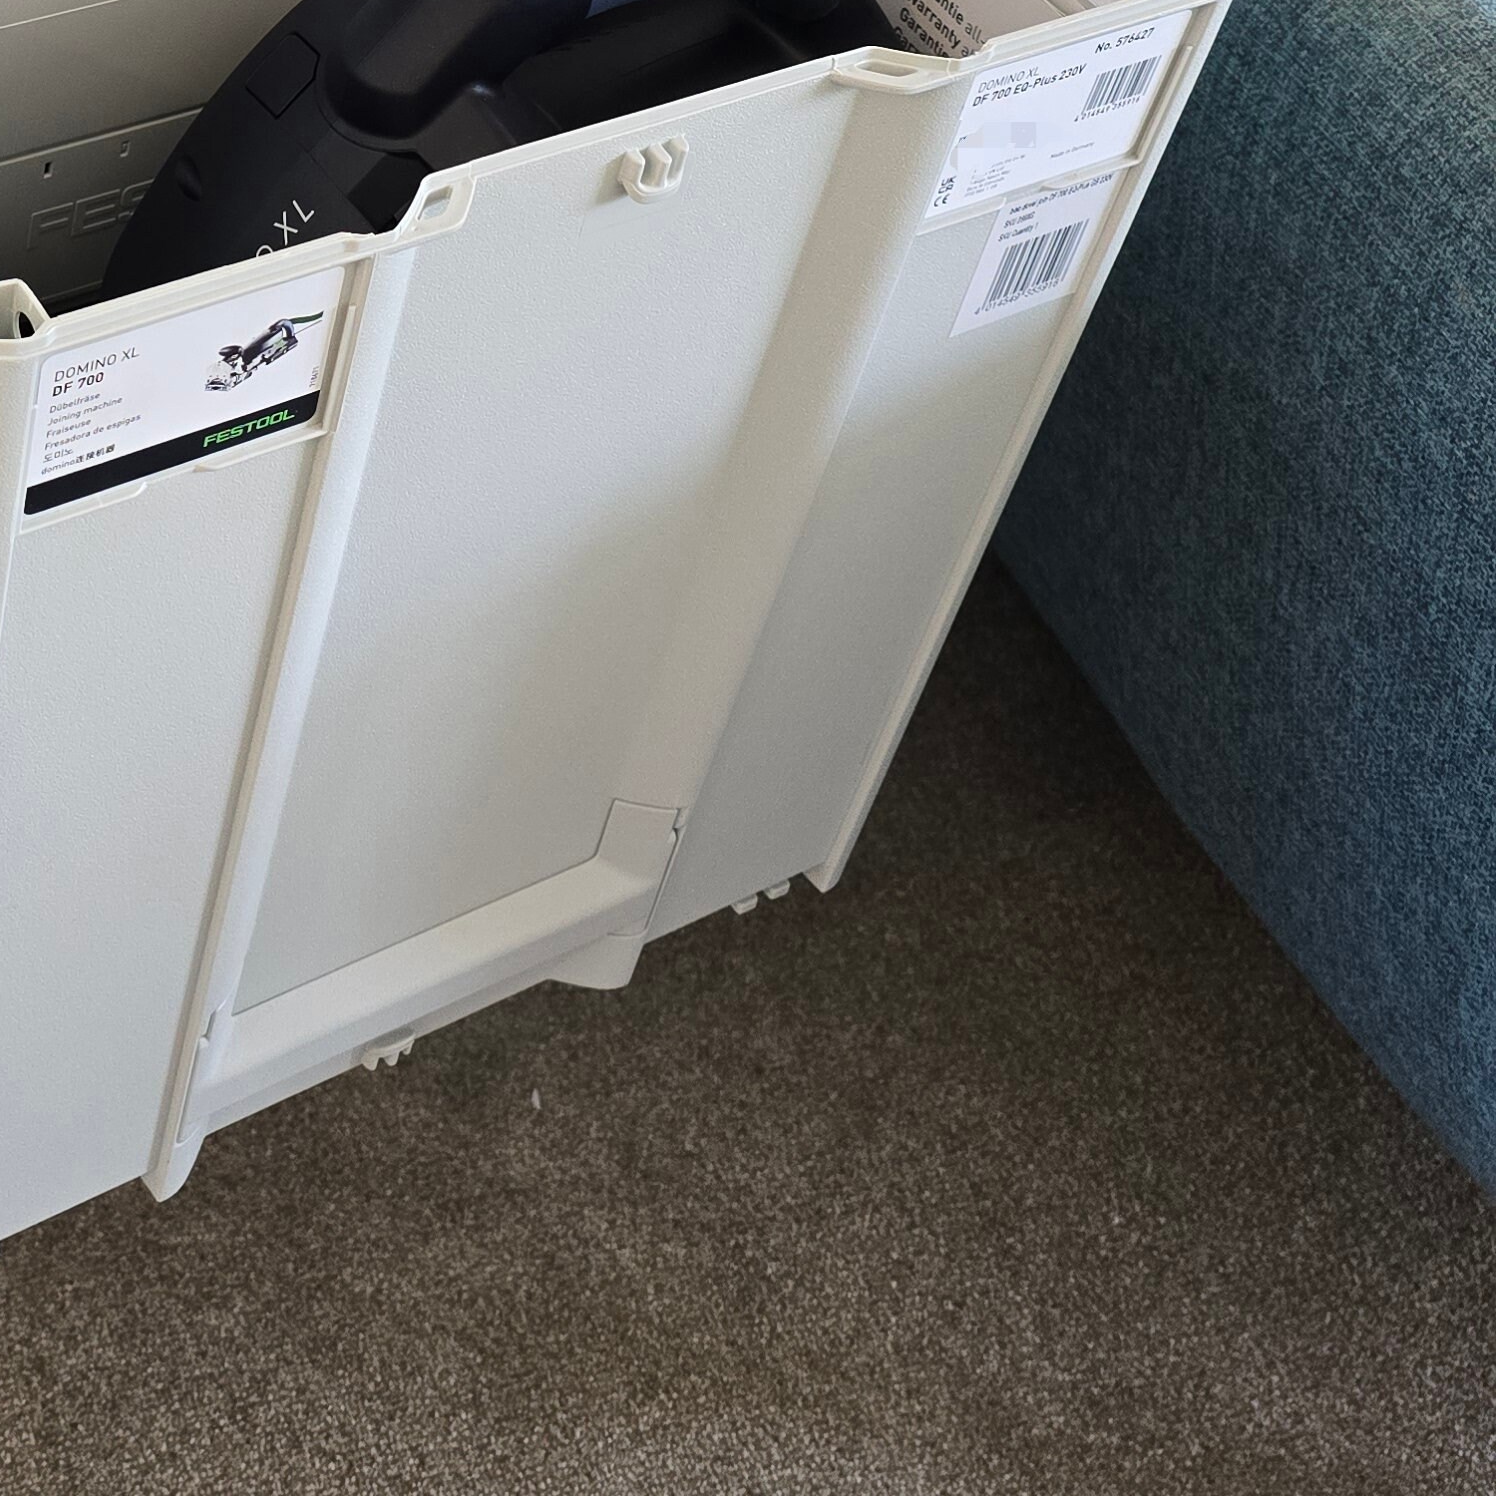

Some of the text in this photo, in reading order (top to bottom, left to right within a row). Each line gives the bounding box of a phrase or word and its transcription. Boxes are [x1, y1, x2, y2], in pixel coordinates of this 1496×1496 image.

[1094, 42, 1112, 54] No.
[972, 63, 1088, 107] DF 700 EQ-Plus 230V
[978, 66, 1040, 94] DOMINO XL
[273, 199, 315, 246] XL
[54, 347, 140, 382] DOMINO XL
[52, 372, 104, 397] DF 700
[47, 397, 123, 427] Joining machine
[49, 393, 101, 414] Dübelfräse
[44, 414, 142, 451] Fresadora de espigas
[46, 419, 92, 439] Fraiseuse
[203, 409, 296, 448] FESTOOL
